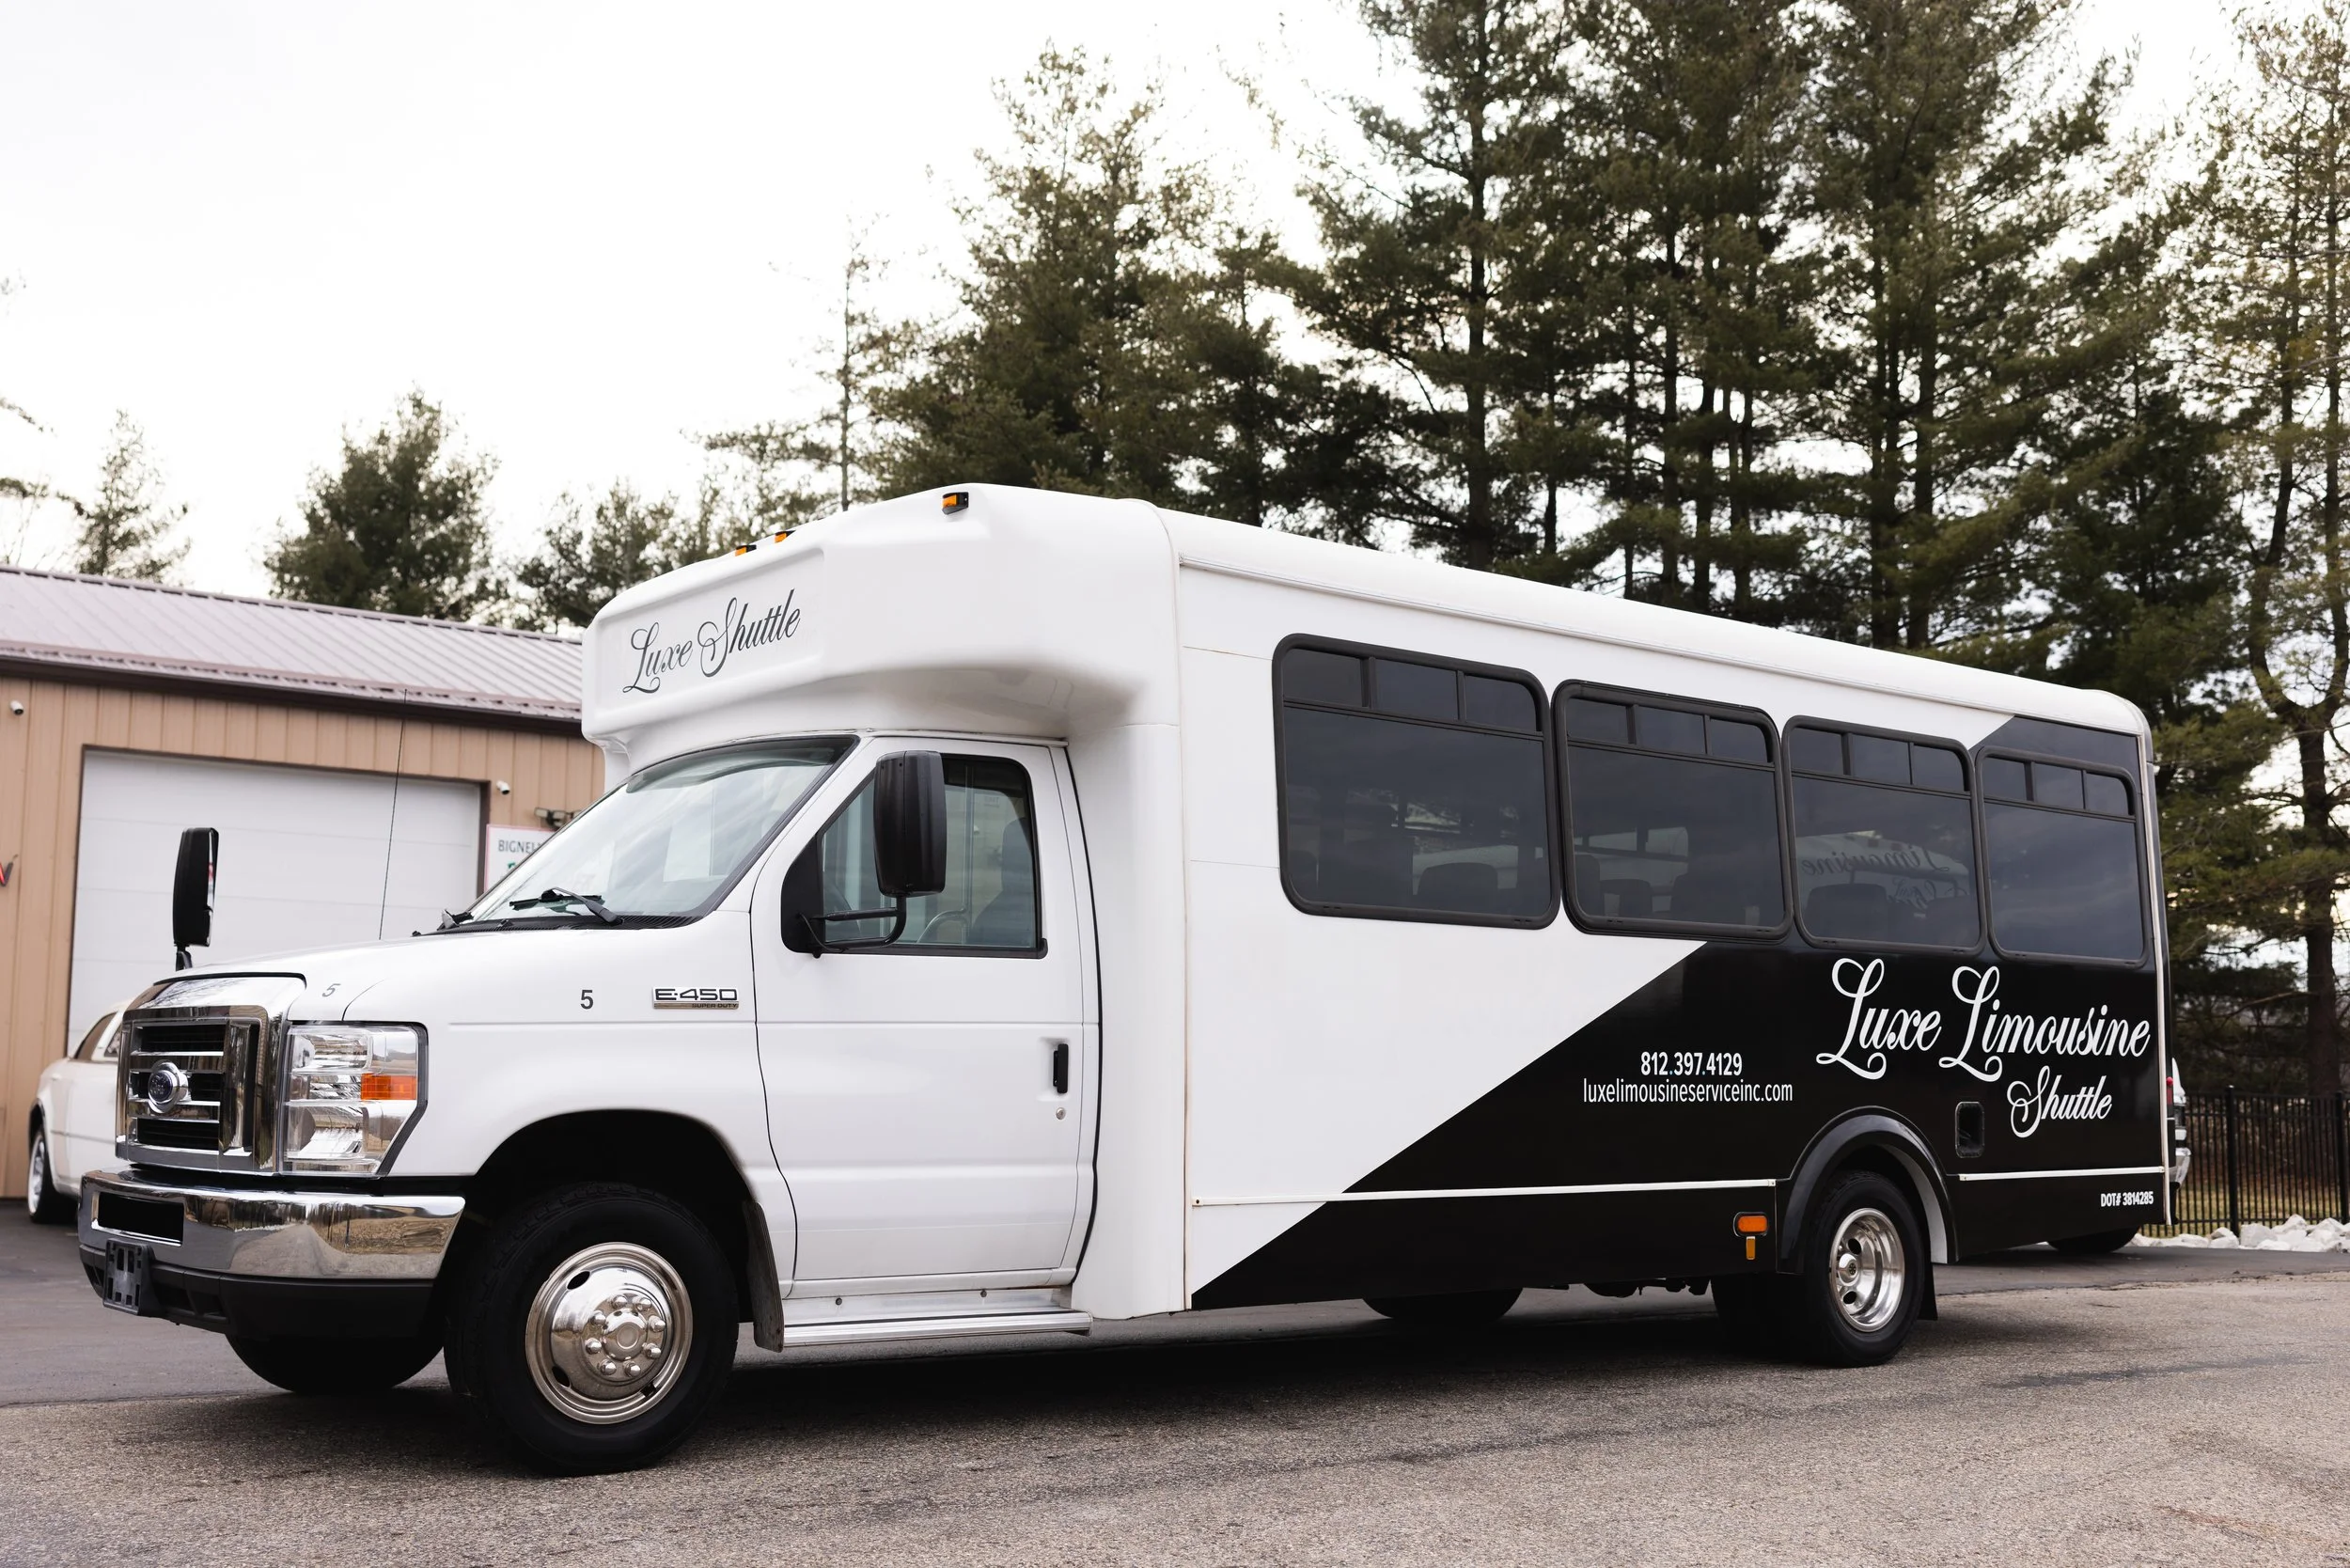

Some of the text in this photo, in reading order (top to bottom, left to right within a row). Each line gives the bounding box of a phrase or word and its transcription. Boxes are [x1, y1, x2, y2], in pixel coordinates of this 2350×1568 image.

[622, 588, 801, 694] Luxe Shuttle
[321, 982, 341, 997] 5
[580, 989, 594, 1010] 5
[655, 988, 738, 1000] E-450
[1816, 957, 2151, 1082] Luxe Limousine
[1640, 1051, 1743, 1075] 812.397.4129
[1583, 1077, 1794, 1103] luxelimousineserviceinc.com
[2006, 1065, 2113, 1138] Shuttle
[2101, 1191, 2154, 1207] DOT# 3814285
